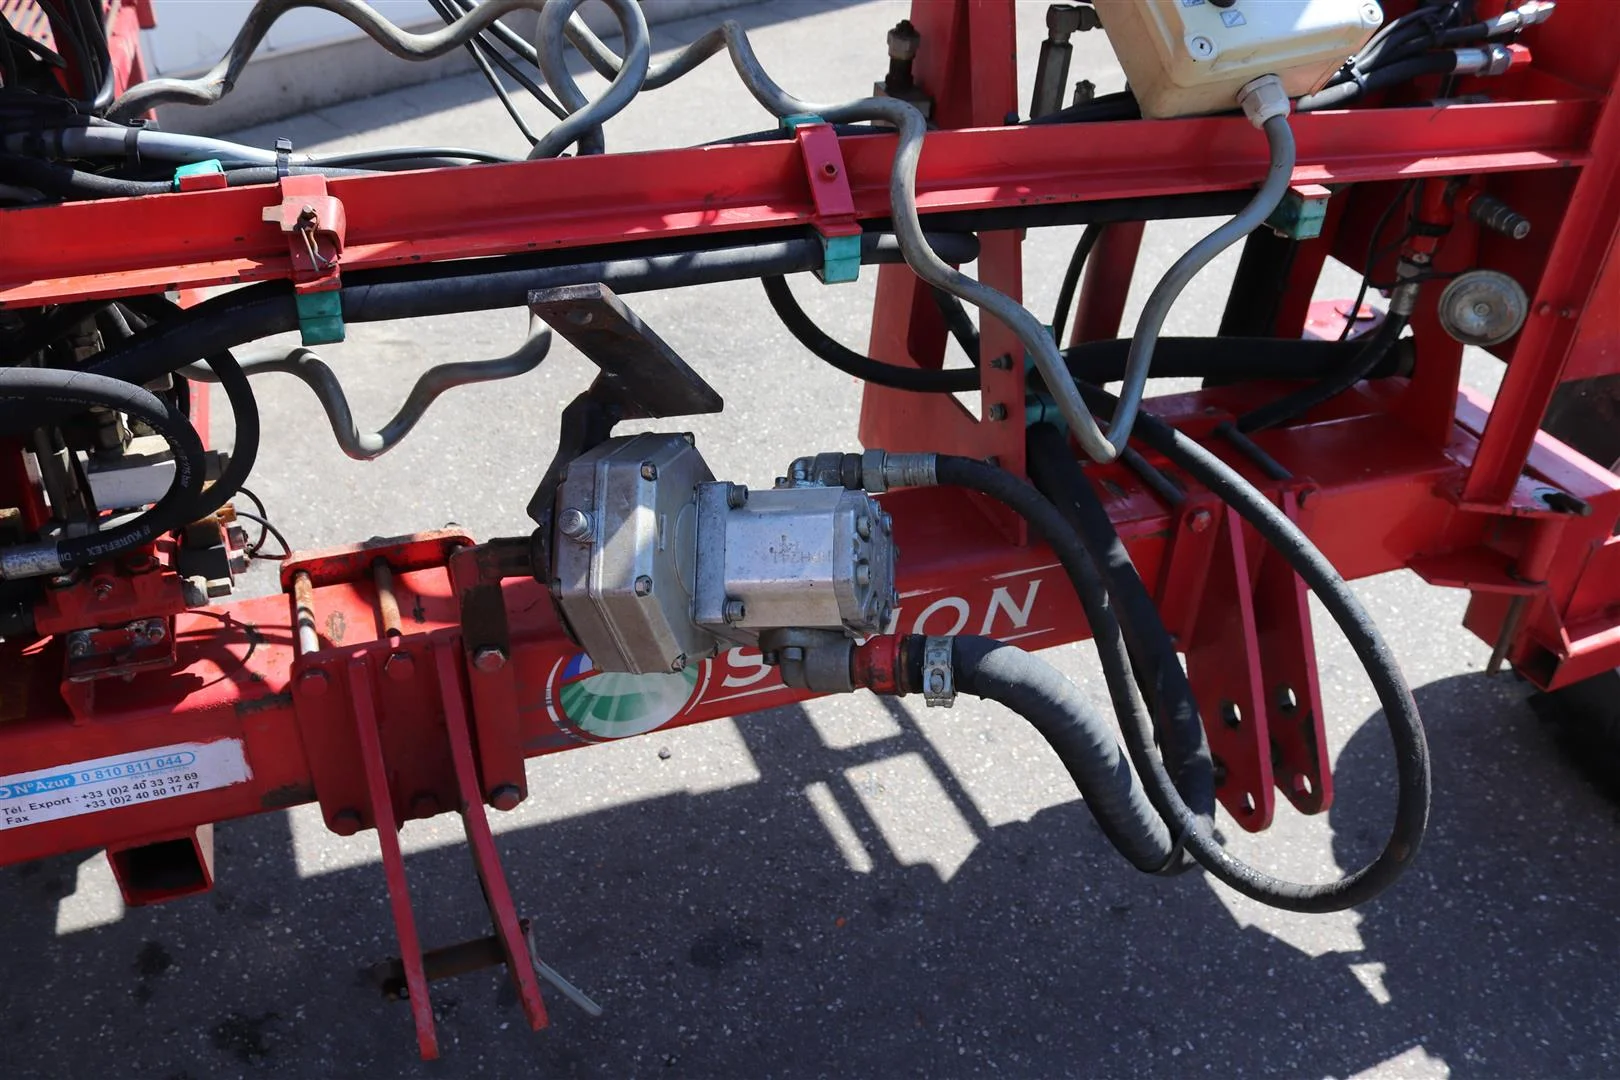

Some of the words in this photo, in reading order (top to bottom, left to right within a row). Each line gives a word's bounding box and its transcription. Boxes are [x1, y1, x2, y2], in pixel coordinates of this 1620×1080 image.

[81, 773, 90, 782] 0
[95, 766, 121, 779] 810
[127, 761, 151, 773] 811
[156, 755, 182, 768] 044
[6, 815, 30, 825] Fax
[85, 799, 106, 809] +33
[110, 794, 132, 806] (0)2
[136, 791, 149, 800] 40
[153, 788, 166, 797] 80
[171, 785, 182, 793] 17
[188, 781, 200, 790] 47
[29, 796, 72, 811] Export
[81, 790, 103, 799] +33
[107, 785, 129, 797] (0)2
[133, 782, 146, 790] 40
[151, 778, 164, 787] 33
[167, 775, 181, 784] 32
[185, 772, 198, 781] 69
